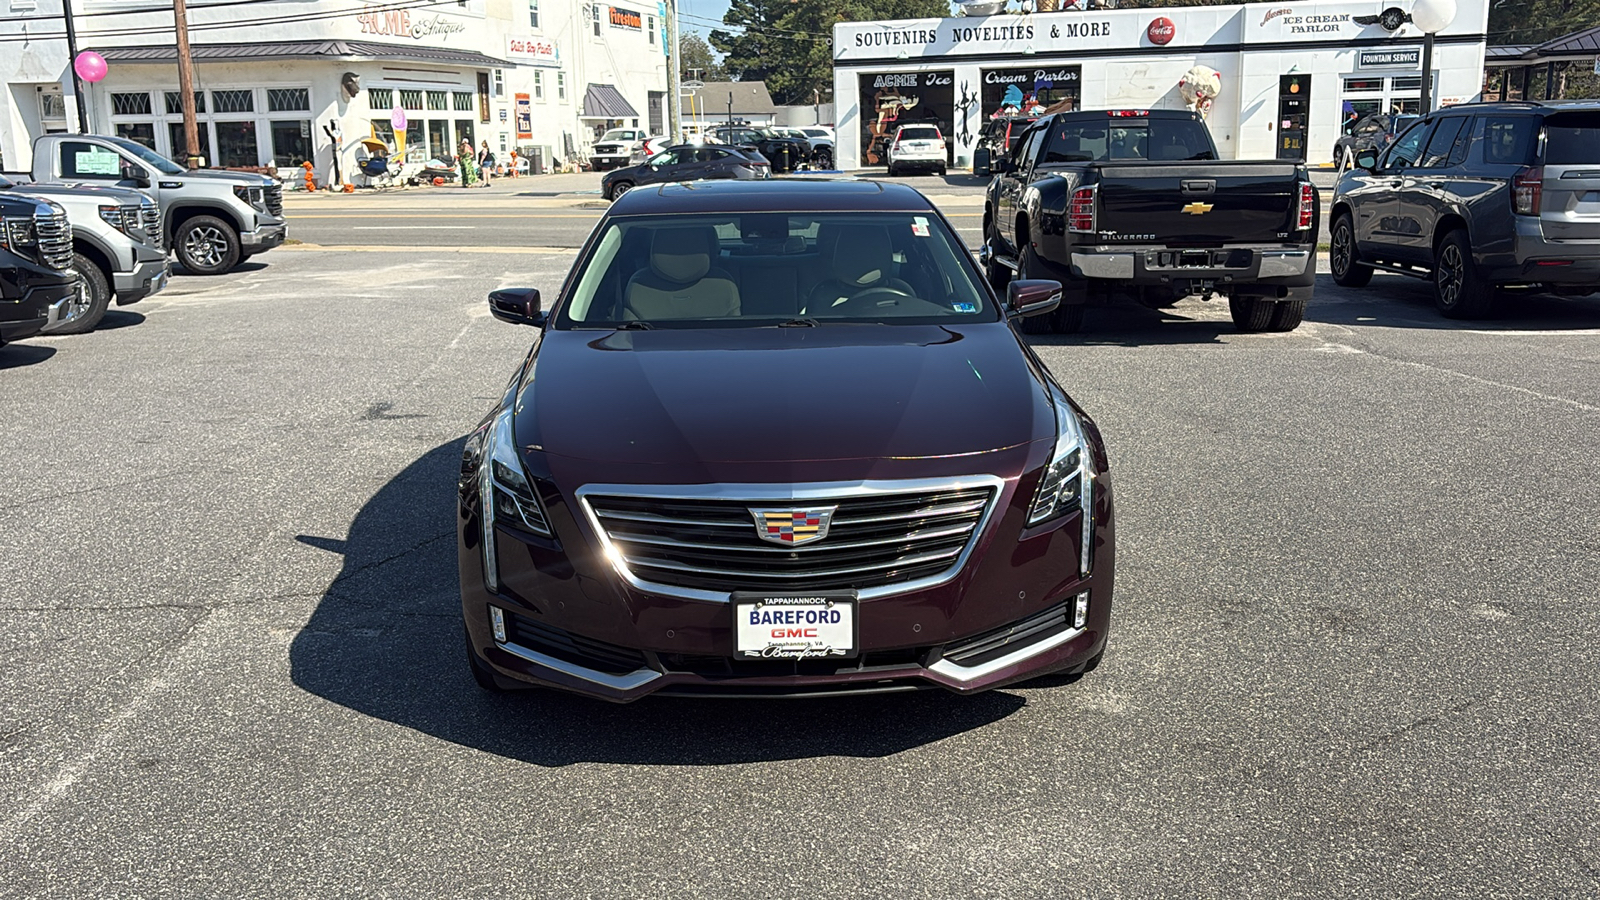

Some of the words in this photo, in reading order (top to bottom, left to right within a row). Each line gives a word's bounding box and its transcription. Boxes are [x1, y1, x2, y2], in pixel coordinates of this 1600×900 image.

[357, 4, 411, 37] ACME
[1283, 17, 1303, 25] ICE
[1305, 14, 1350, 23] CREAM
[855, 29, 937, 47] SOUVENIRS
[952, 25, 1034, 43] NOVELTIES
[1050, 24, 1060, 38] &
[1067, 22, 1110, 37] MORE
[1291, 24, 1340, 34] PARLOR
[527, 41, 536, 56] Boy
[1362, 53, 1392, 64] FOUNTAIN
[1393, 52, 1417, 62] SERVICE
[873, 74, 917, 88] ACME
[925, 73, 951, 86] Ice
[985, 71, 1027, 84] Cream
[1033, 69, 1079, 83] Parlor
[764, 597, 826, 605] TAPPAHANNOCK
[750, 610, 841, 625] BAREFORD
[771, 628, 818, 638] GMC
[762, 645, 831, 661] Bareford
